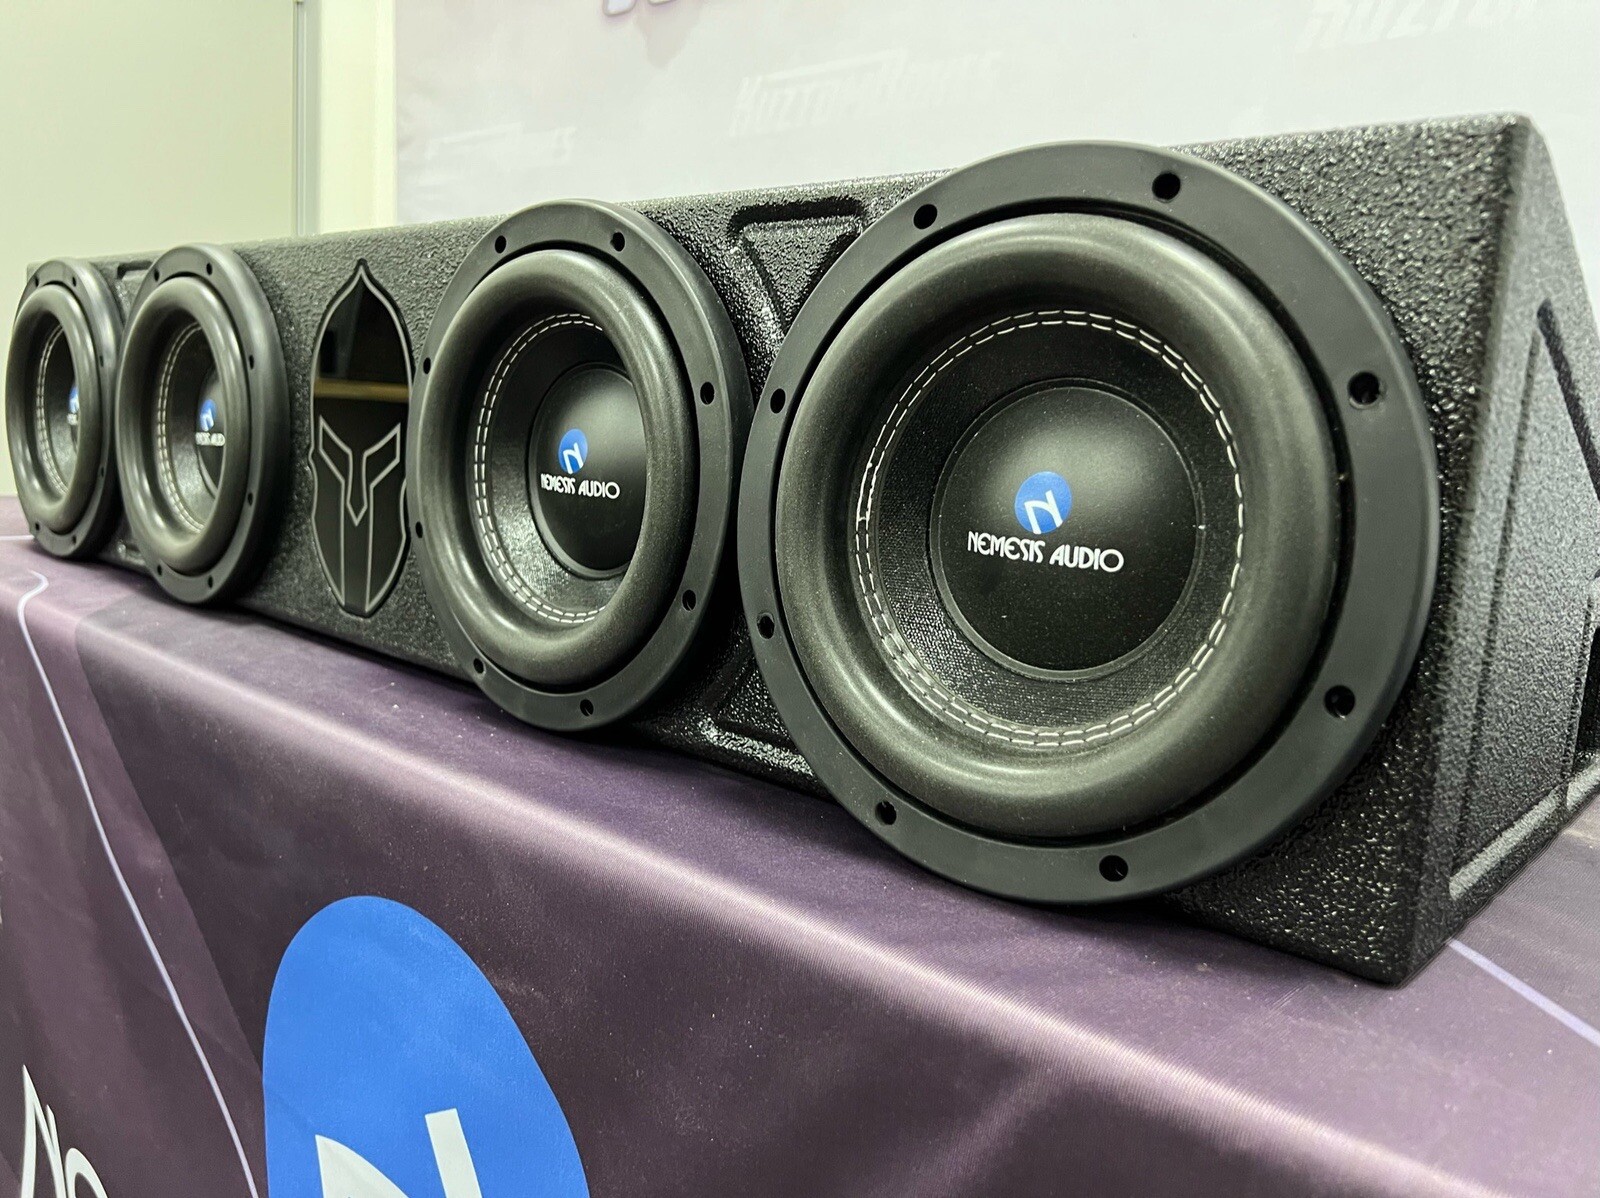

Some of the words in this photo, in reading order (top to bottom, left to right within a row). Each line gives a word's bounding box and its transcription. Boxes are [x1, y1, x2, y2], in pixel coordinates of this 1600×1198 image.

[541, 473, 576, 495] NEMESIS
[578, 480, 620, 499] AUDIO
[967, 531, 1046, 564] NEMESIS
[1049, 544, 1125, 573] AUDIO
